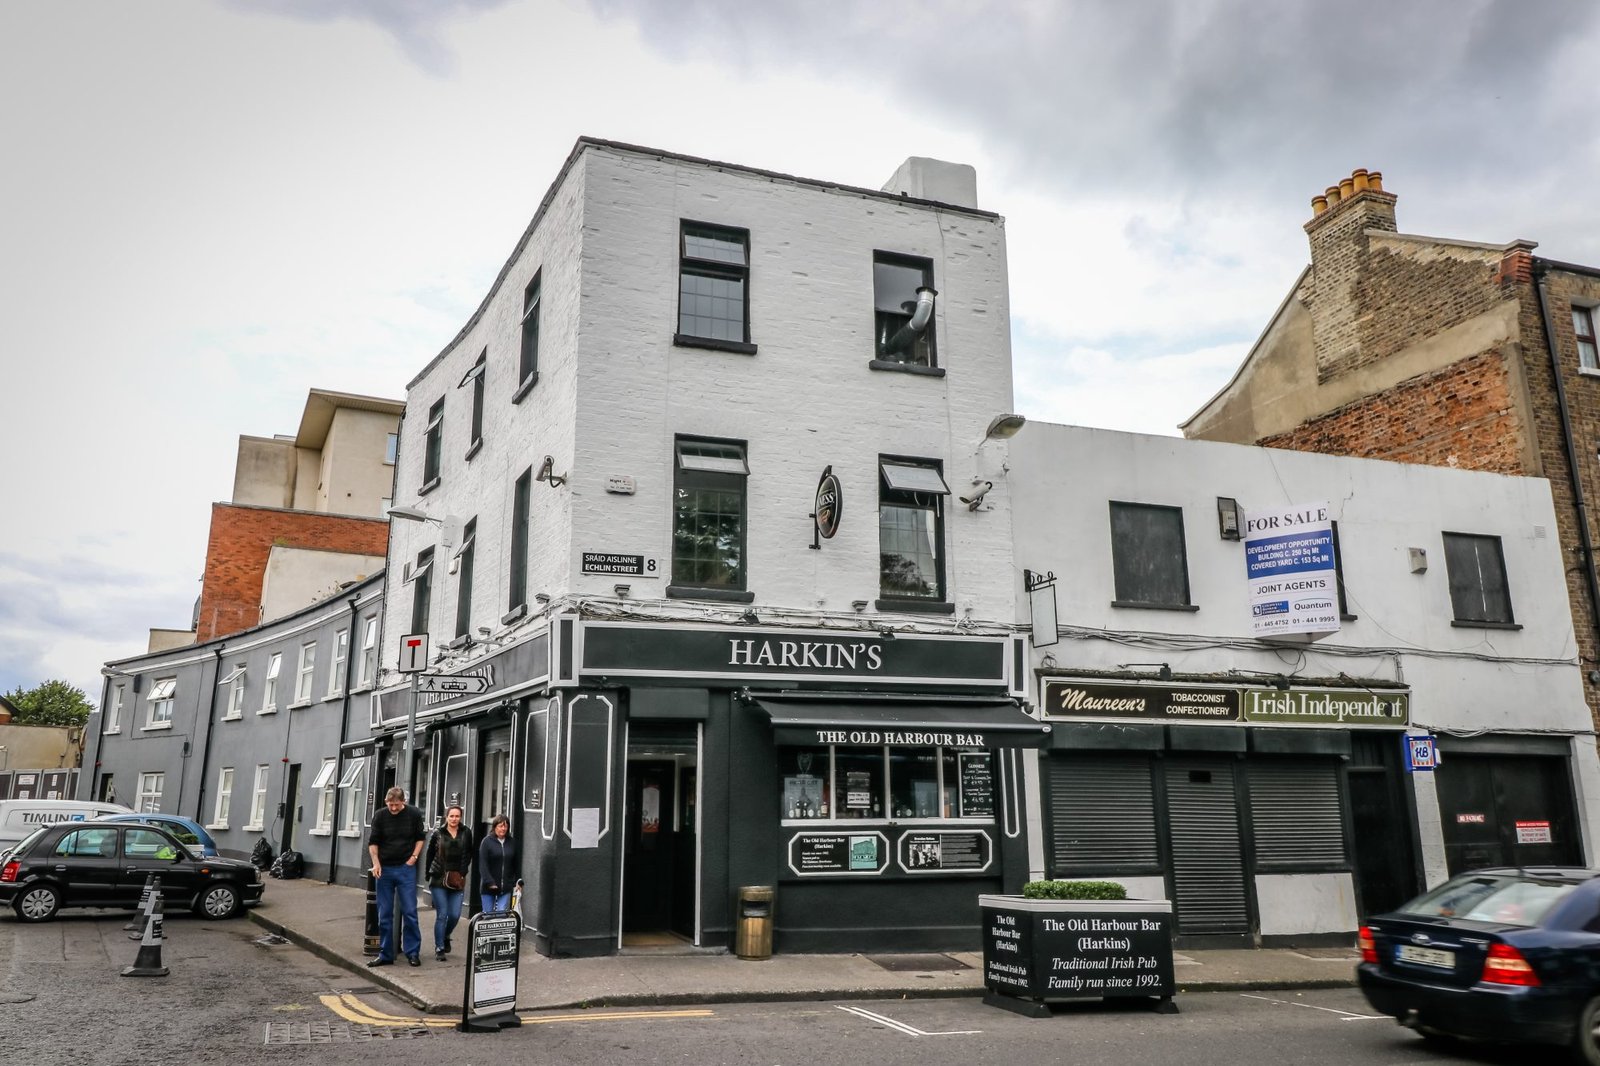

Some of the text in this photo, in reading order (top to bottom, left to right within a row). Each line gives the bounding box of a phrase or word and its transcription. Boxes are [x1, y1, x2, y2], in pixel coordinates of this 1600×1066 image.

[1247, 508, 1328, 532] FOR SALE
[1248, 537, 1330, 555] DEVELOPMENT OPPORTUNITY
[607, 556, 637, 564] AISLINNE
[1258, 551, 1284, 561] BUILDING
[647, 559, 656, 572] 8
[1251, 560, 1276, 571] COVERED
[1257, 580, 1326, 595] JOINT AGENTS
[1294, 602, 1332, 611] Quantum
[728, 639, 882, 670] HARKIN'S
[1060, 688, 1146, 713] Maureen's
[1172, 694, 1226, 703] TOBACCONIST
[1250, 692, 1296, 716] Irish
[1166, 705, 1230, 716] CONFECTIONERY
[816, 730, 985, 747] THE OLD HARBOUR BAR
[1415, 746, 1429, 758] HB
[22, 813, 70, 822] TIMLIN
[996, 915, 1015, 925] The Old
[1042, 919, 1161, 931] The Old Harbour Bar
[992, 928, 1021, 939] Harbour Bar
[996, 940, 1018, 954] (Harkins)
[1077, 937, 1131, 952] (Harkins)
[989, 960, 1027, 976] Traditional Irish Pub
[1052, 956, 1157, 970] Traditional Irish Pub
[988, 972, 1000, 983] Family
[1008, 976, 1017, 985] since
[1048, 975, 1162, 991] Family run since 1992.
